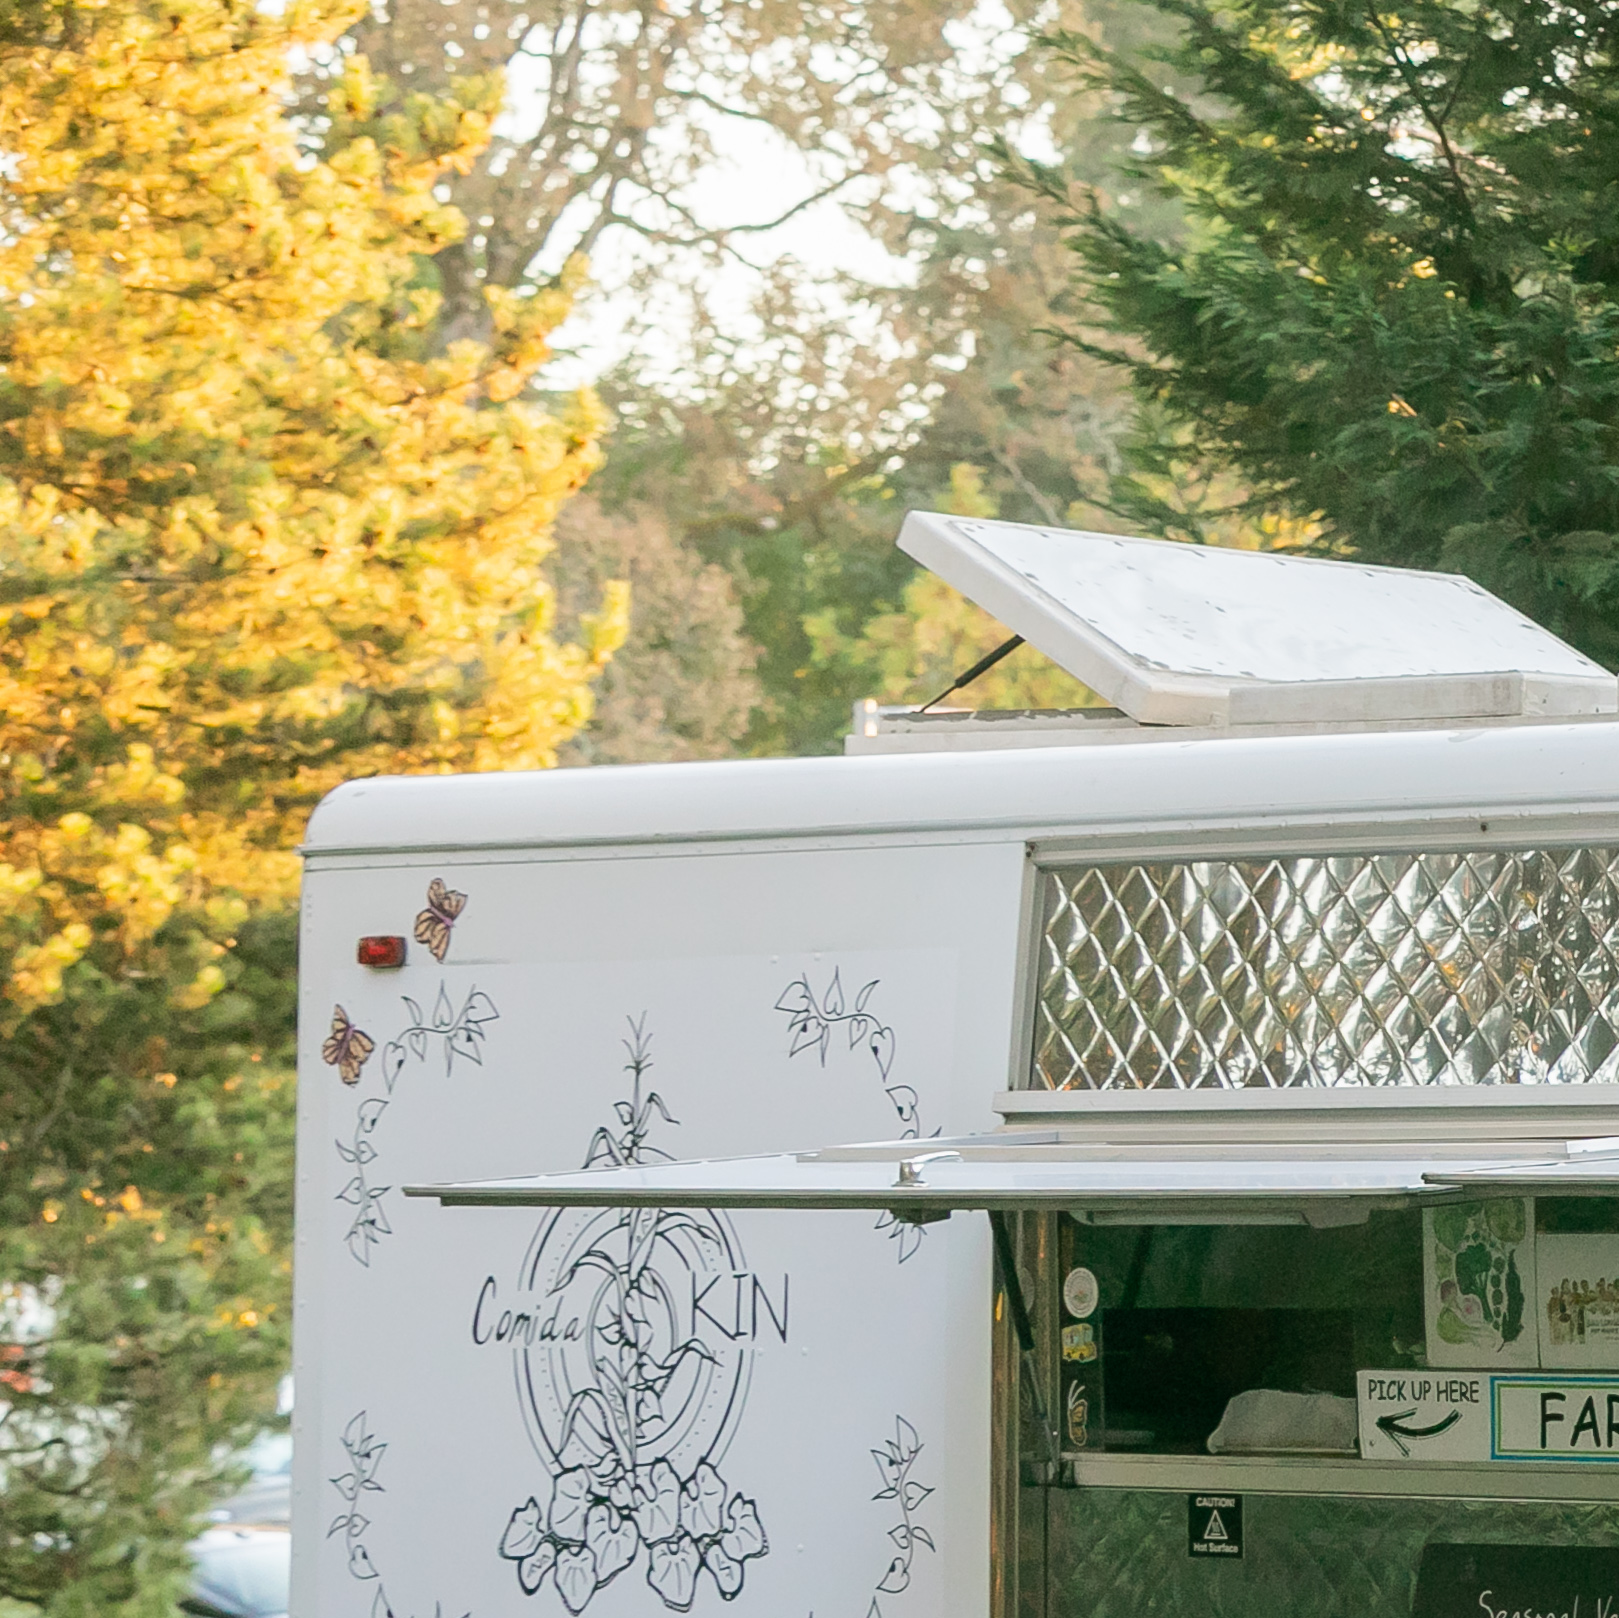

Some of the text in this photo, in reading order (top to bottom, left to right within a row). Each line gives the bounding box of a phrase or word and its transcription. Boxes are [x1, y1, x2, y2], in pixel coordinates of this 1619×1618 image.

[472, 1272, 790, 1347] Comida KIN
[1367, 1380, 1480, 1403] PICK UP HERE
